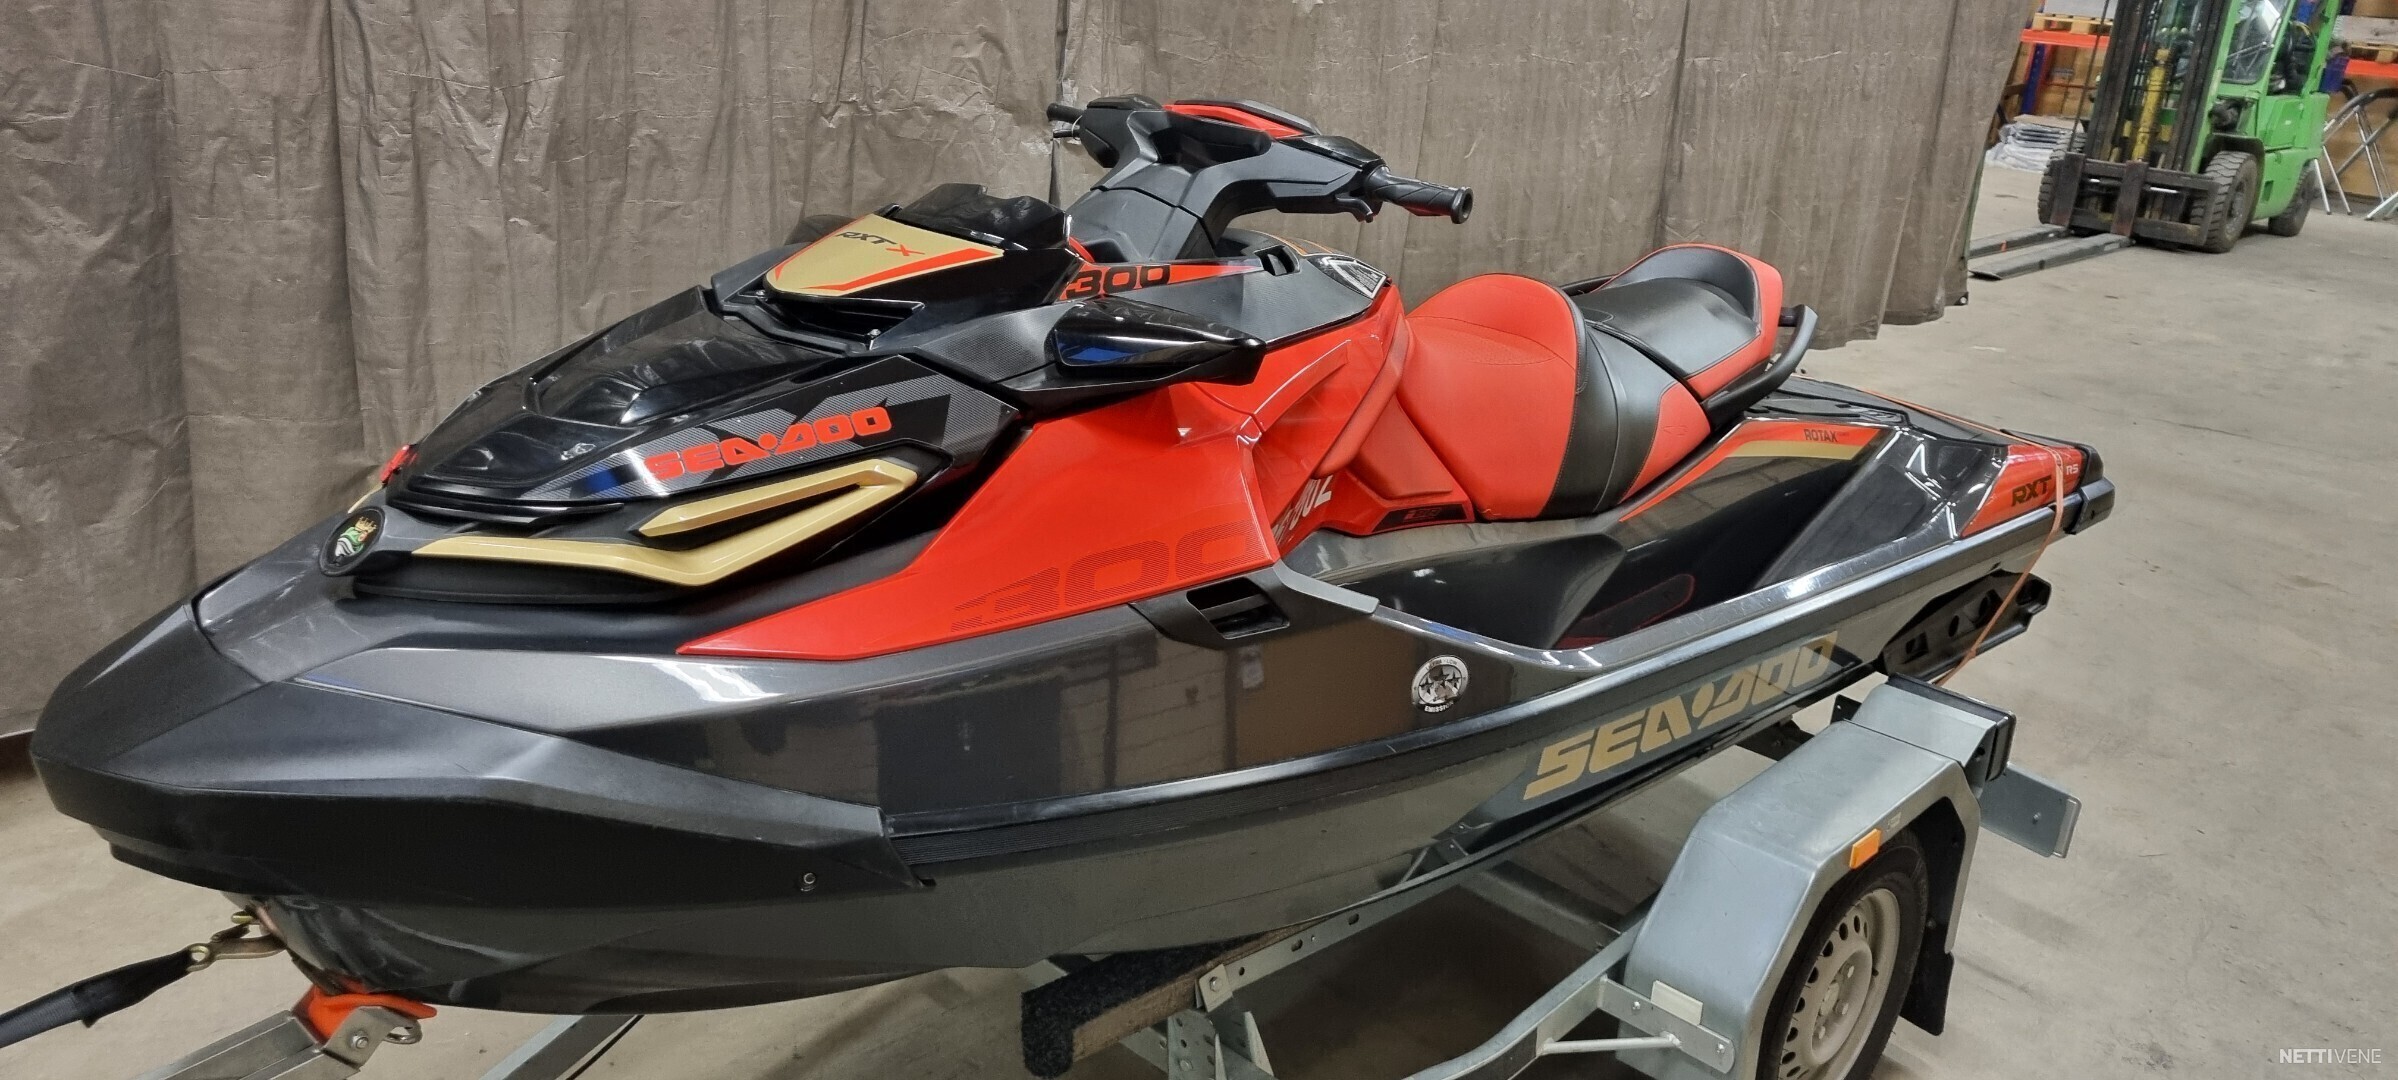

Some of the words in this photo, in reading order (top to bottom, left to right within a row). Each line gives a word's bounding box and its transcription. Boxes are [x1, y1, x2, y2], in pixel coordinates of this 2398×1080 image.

[1065, 264, 1171, 300] 300
[1803, 428, 1839, 443] ROTAX
[2011, 474, 2053, 507] RXT
[950, 519, 1266, 633] 300
